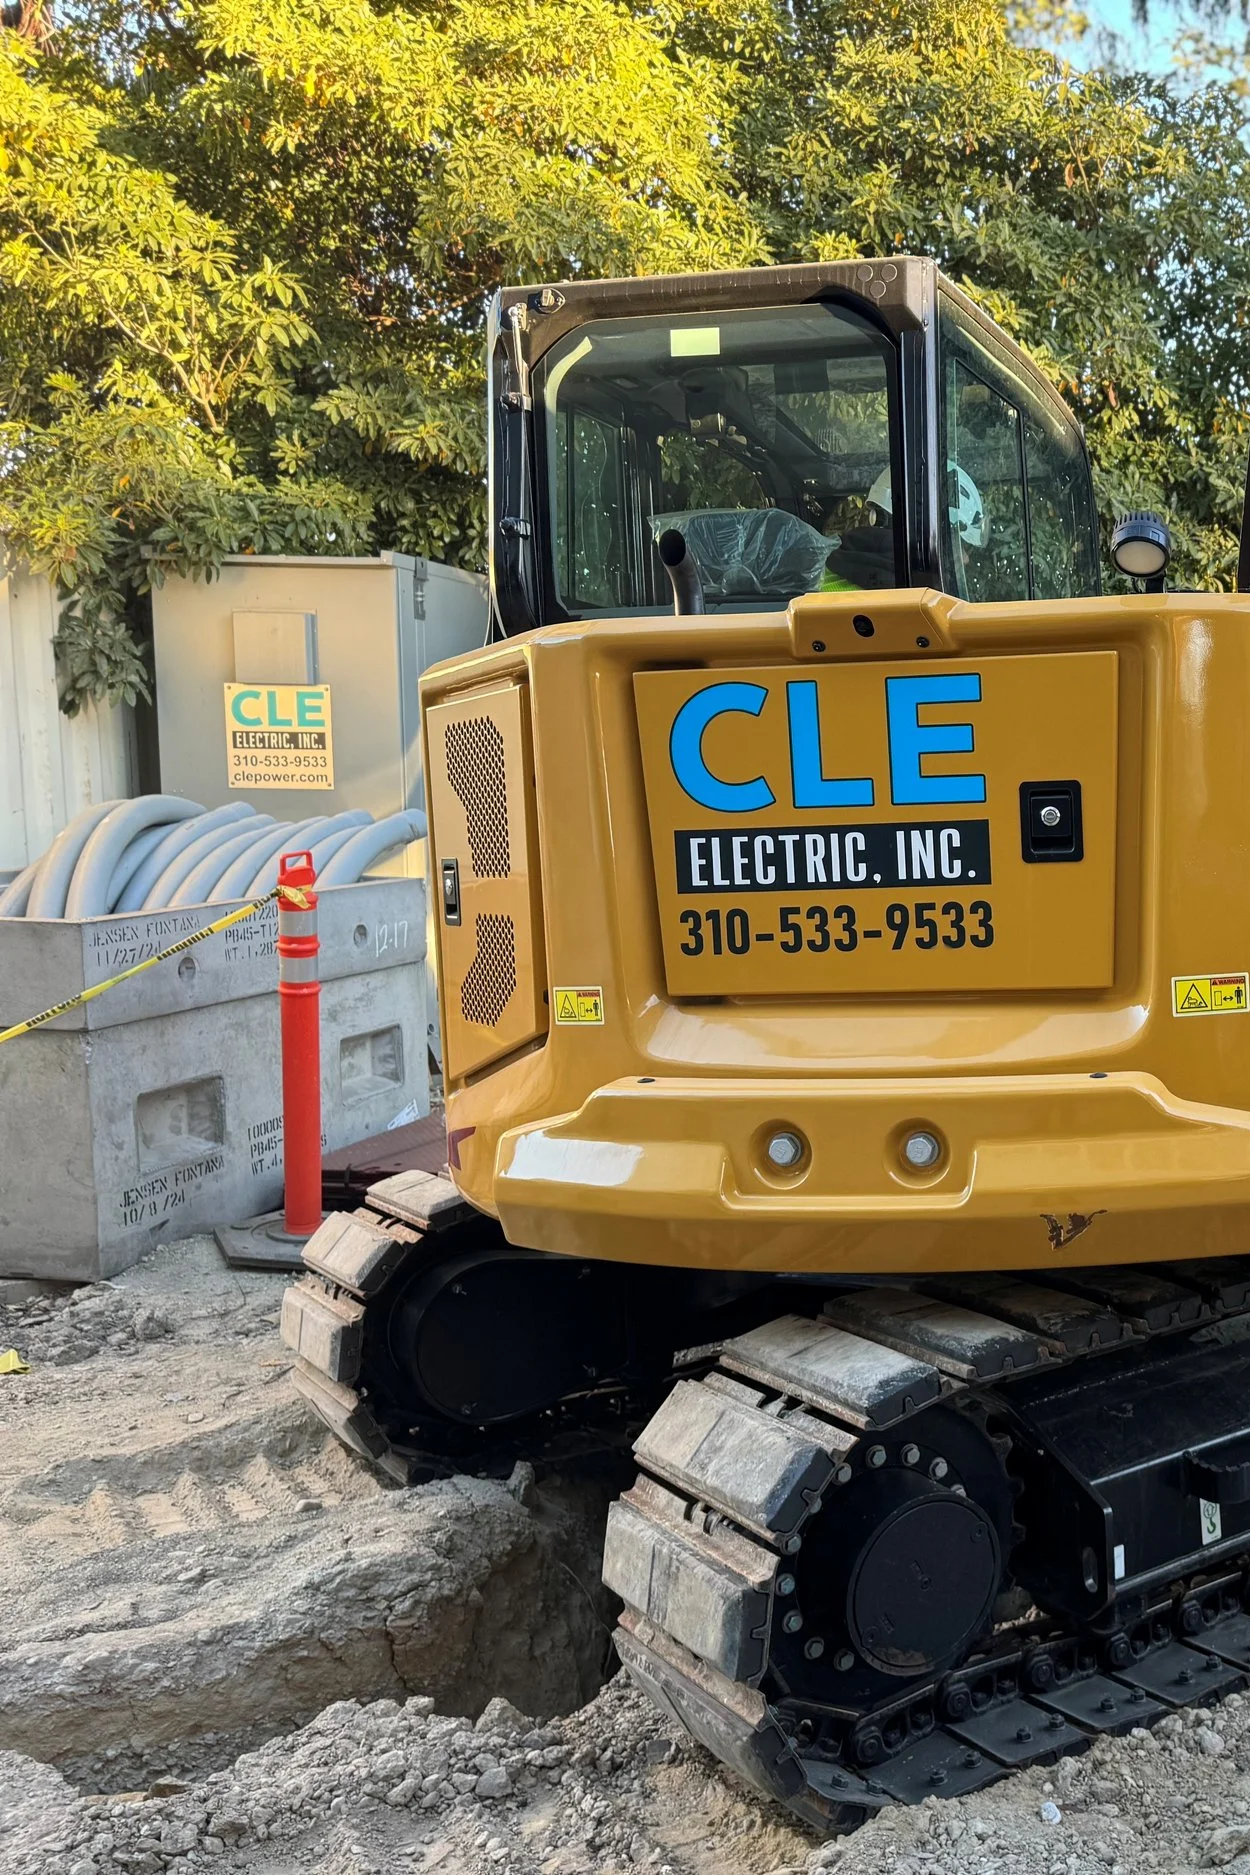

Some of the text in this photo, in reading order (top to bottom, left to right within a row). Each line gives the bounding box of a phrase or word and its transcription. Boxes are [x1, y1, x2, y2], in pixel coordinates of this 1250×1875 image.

[231, 690, 326, 727] CLE
[235, 731, 323, 749] ELECTRIC, INC.
[669, 673, 987, 813] CLE
[233, 754, 328, 768] 310-533-9533
[233, 770, 329, 785] clepower.com
[688, 828, 977, 886] ELECTRIC, INC.
[89, 925, 140, 947] JENSEN
[146, 915, 201, 939] FONTANA
[679, 900, 995, 956] 310-533-9533
[97, 940, 162, 968] 11/27/24
[119, 1155, 225, 1208] JENSEN FONTANA
